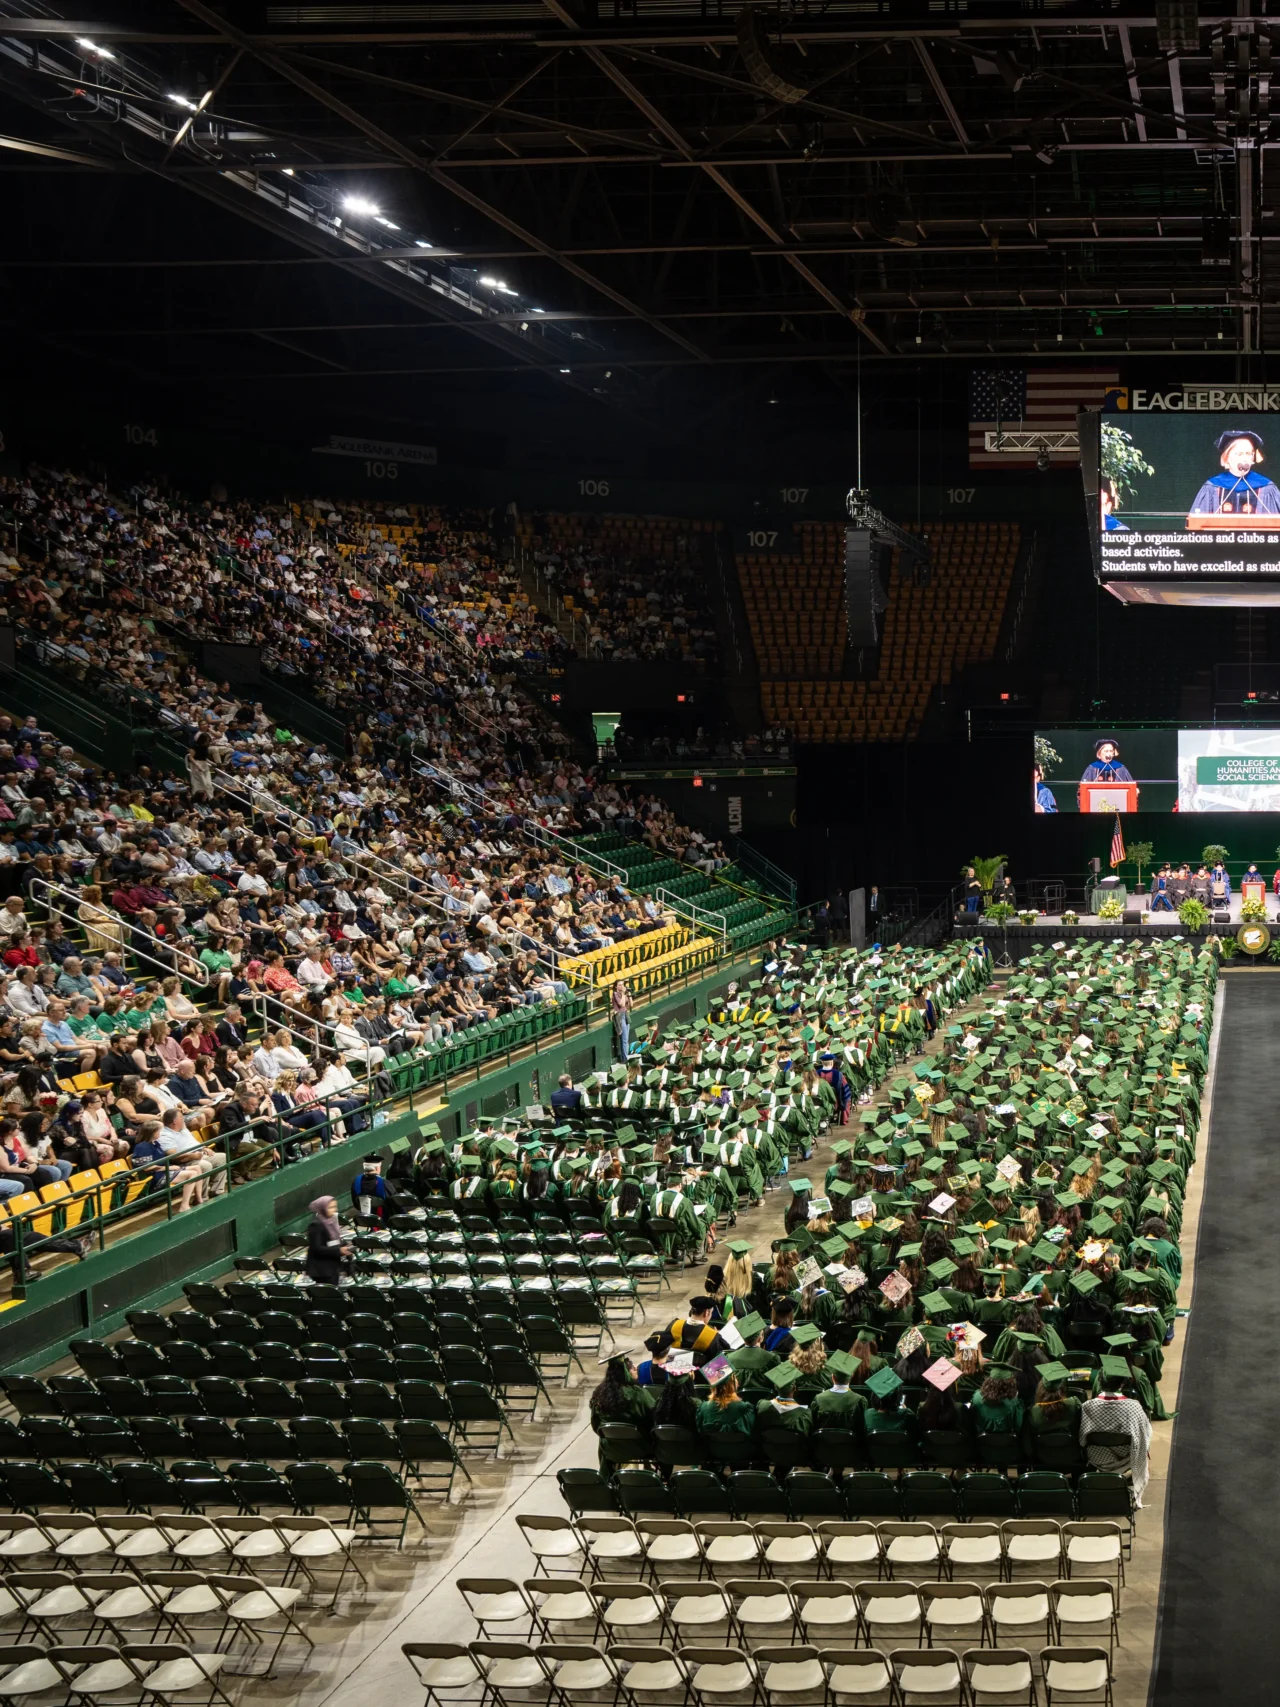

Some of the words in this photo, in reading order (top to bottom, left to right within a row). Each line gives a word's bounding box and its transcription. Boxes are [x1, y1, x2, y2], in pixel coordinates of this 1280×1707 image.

[123, 422, 159, 447] 104
[363, 460, 399, 480] 105
[577, 479, 610, 497] 106
[780, 487, 809, 504] 107
[946, 487, 976, 504] 107
[746, 530, 779, 547] 107
[1101, 532, 1142, 545] through
[1144, 532, 1213, 545] organizations
[1215, 532, 1236, 544] and
[1237, 532, 1265, 544] clubs
[1267, 534, 1279, 544] as
[1101, 546, 1132, 558] based
[1133, 546, 1184, 558] activities.
[1101, 560, 1146, 572] Students
[1148, 560, 1172, 572] who
[1173, 560, 1199, 572] have
[1200, 560, 1244, 572] excelled
[1246, 562, 1258, 572] as
